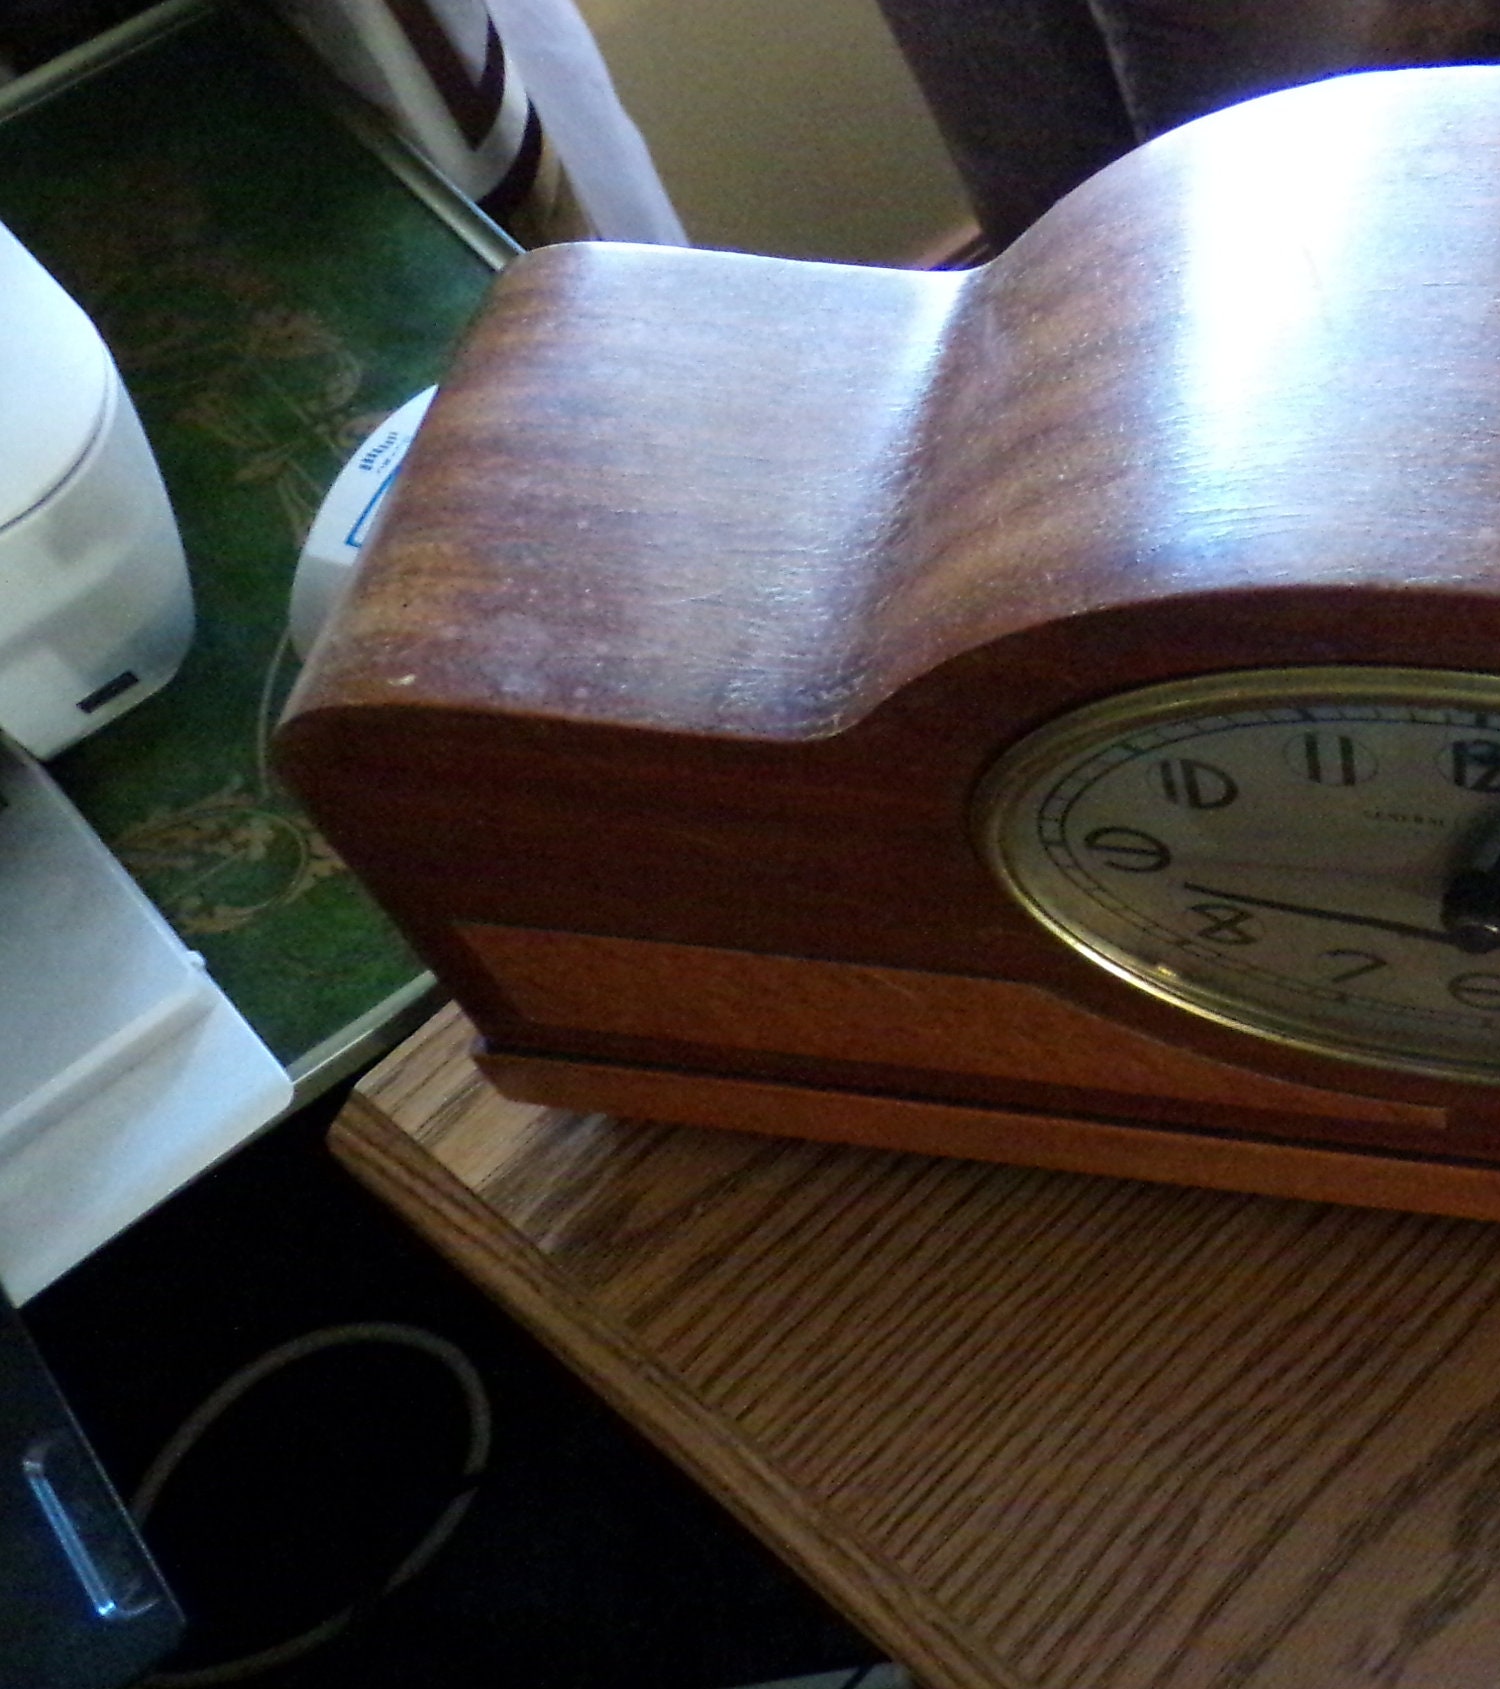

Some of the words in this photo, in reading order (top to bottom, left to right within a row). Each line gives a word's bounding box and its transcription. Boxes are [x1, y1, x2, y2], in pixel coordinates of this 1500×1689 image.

[1303, 732, 1357, 787] 11
[1158, 758, 1239, 811] 10
[1083, 825, 1173, 874] 9
[1187, 902, 1258, 946] 8
[1318, 948, 1388, 984] 7
